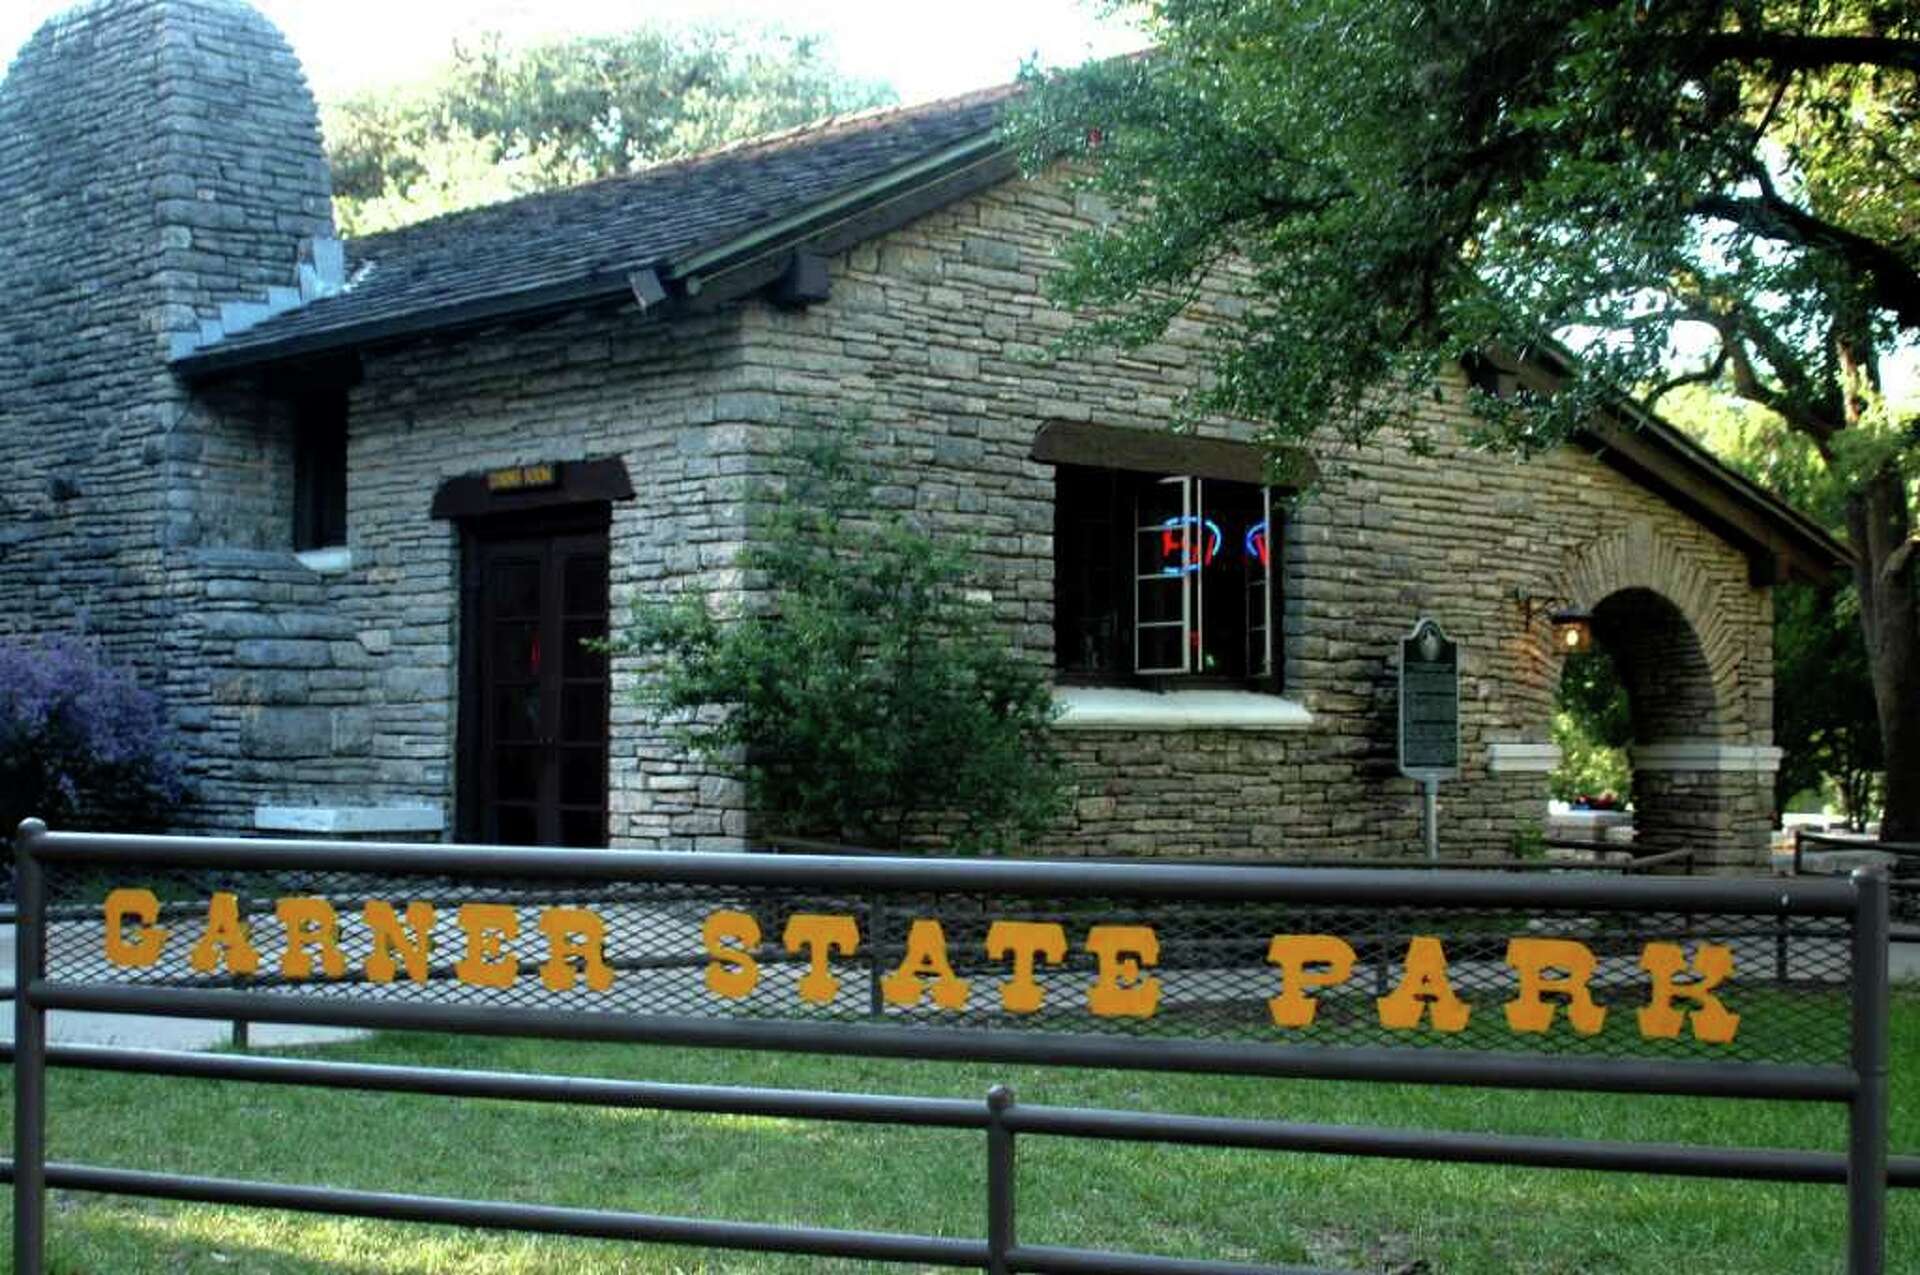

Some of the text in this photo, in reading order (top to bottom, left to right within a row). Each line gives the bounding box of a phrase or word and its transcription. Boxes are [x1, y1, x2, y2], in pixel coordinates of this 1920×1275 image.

[103, 888, 1739, 1042] GARNER STATE PARK
